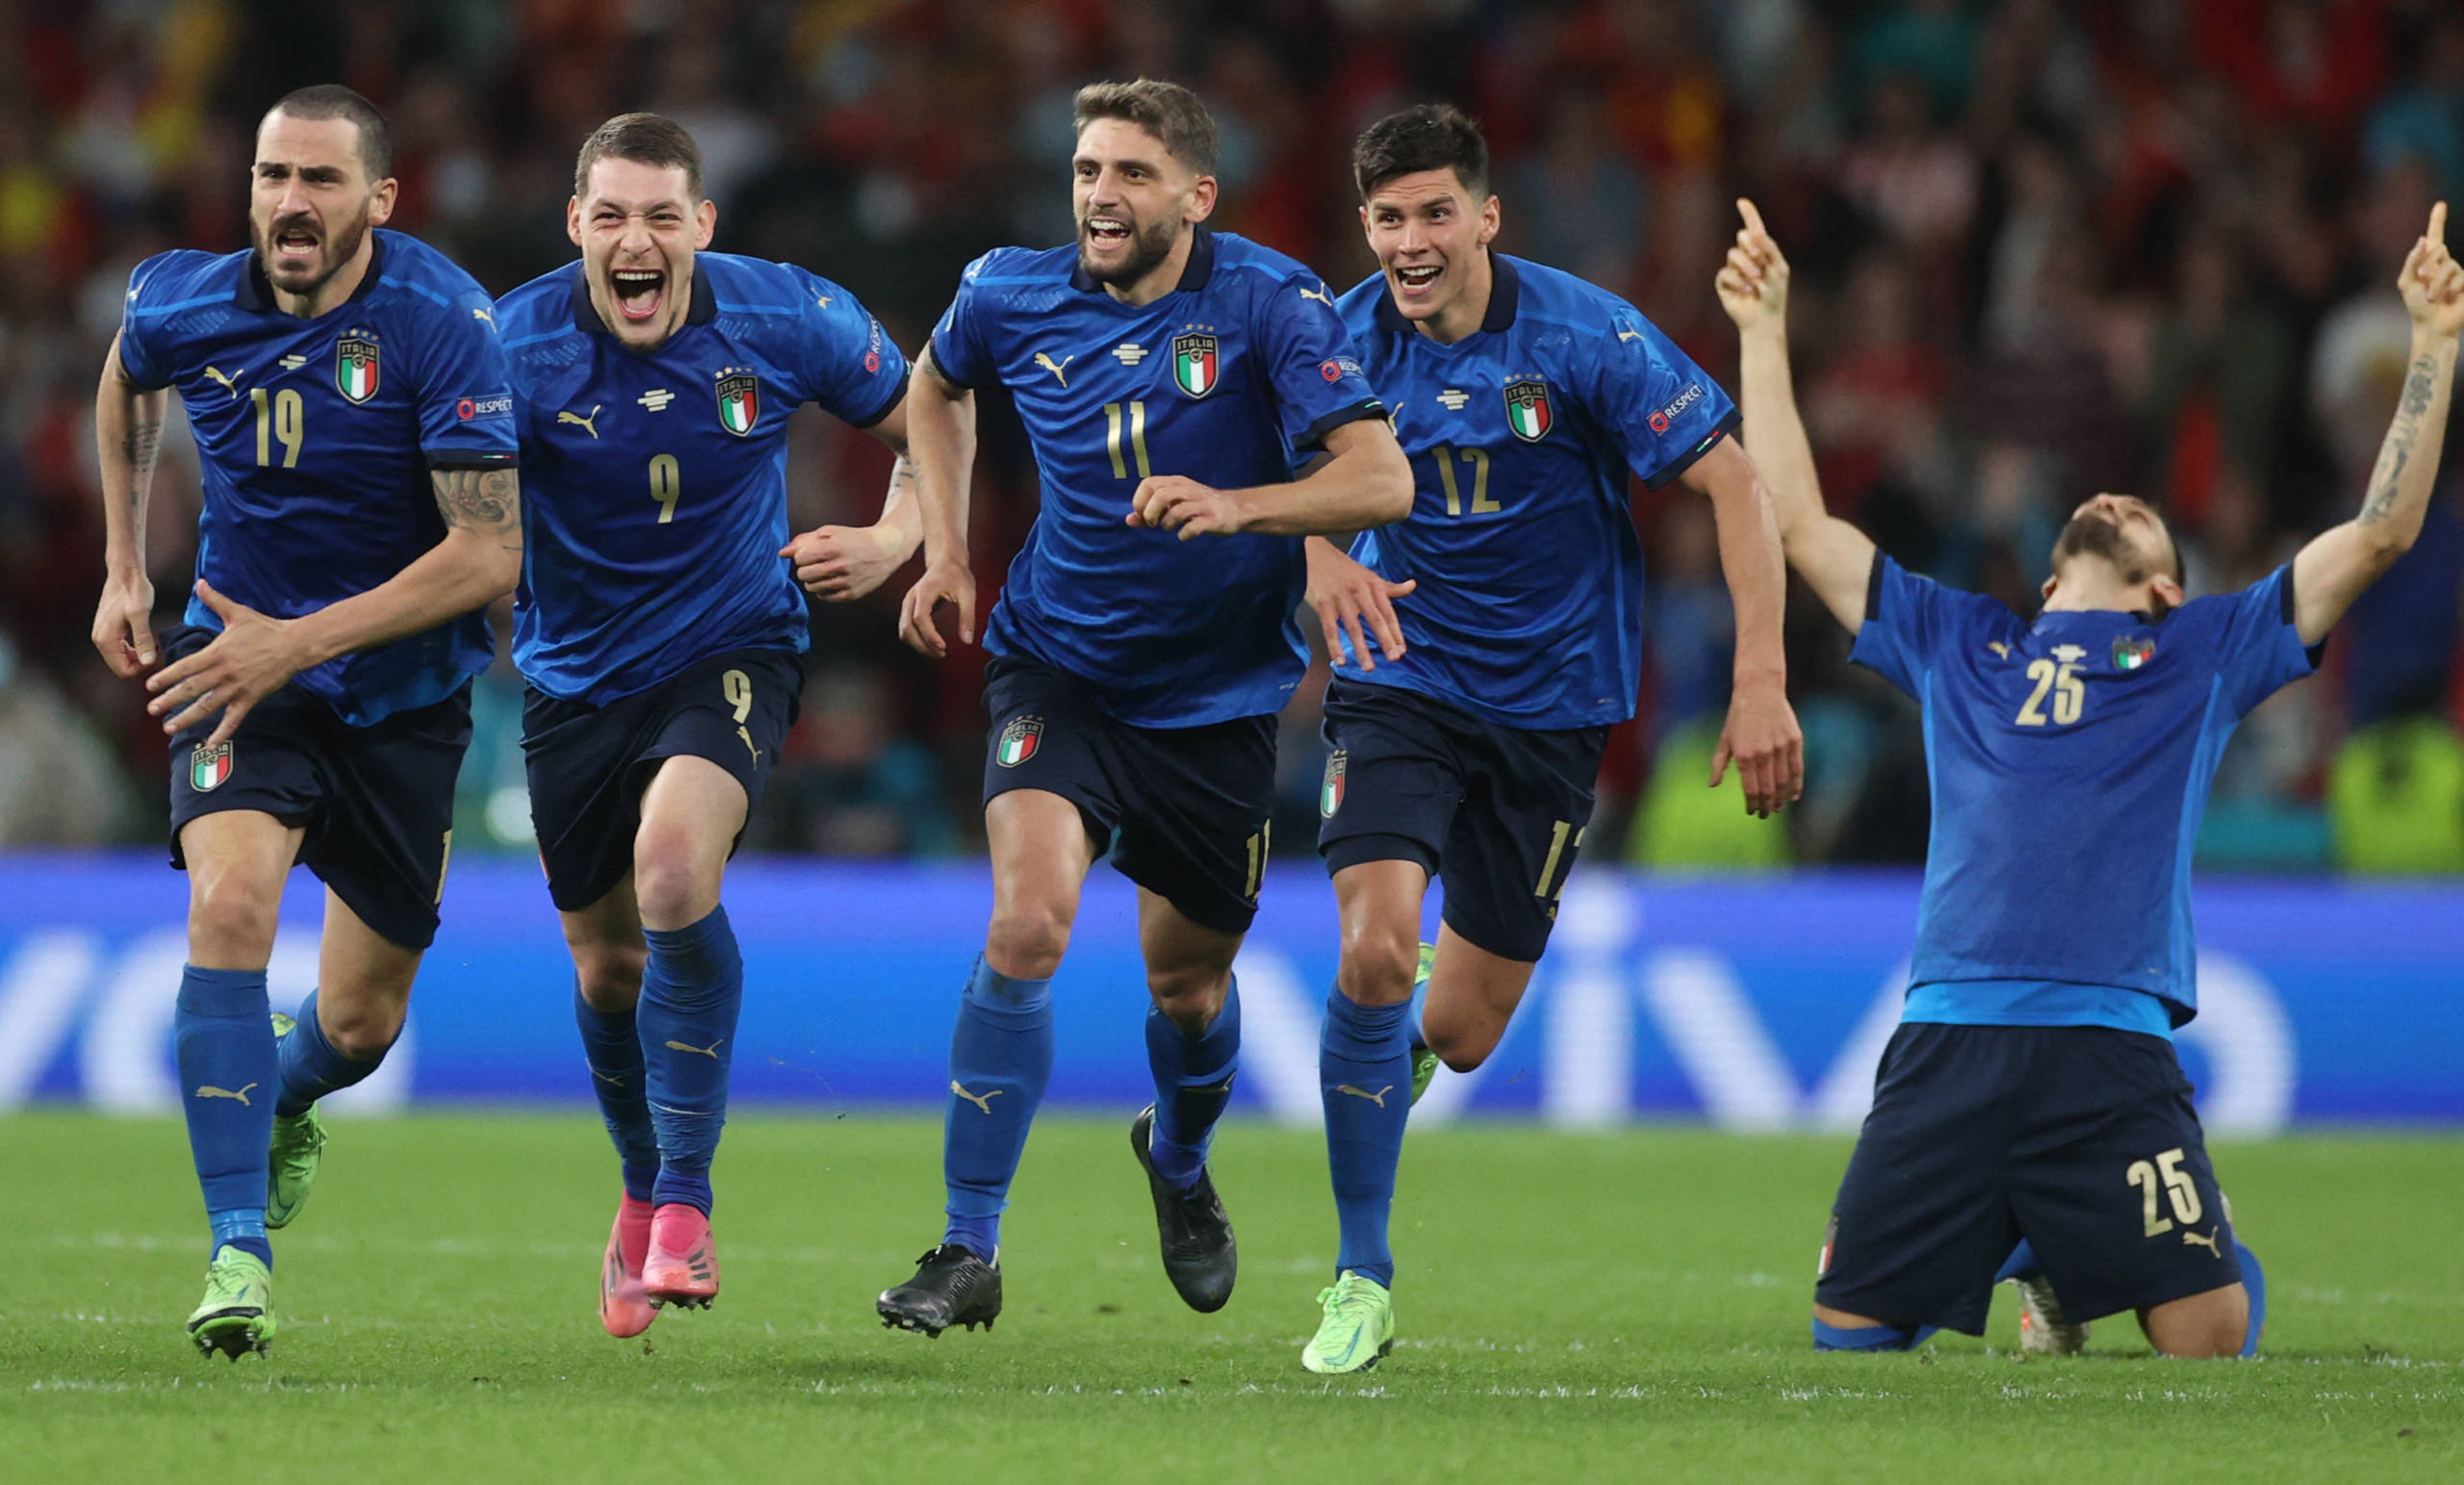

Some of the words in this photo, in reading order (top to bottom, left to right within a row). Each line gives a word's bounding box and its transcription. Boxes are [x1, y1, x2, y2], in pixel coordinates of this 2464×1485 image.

[341, 344, 376, 356] ITALIA
[1176, 338, 1214, 349] ITALIA
[475, 398, 513, 414] RESPECT
[719, 378, 754, 395] ITALIA
[1507, 386, 1545, 398] ITALIA
[1664, 384, 1703, 419] RESPECT
[250, 388, 303, 469] 19
[1104, 401, 1151, 479] 11
[648, 453, 680, 524] 9
[1431, 448, 1502, 516] 12
[722, 669, 752, 724] 9
[2015, 658, 2087, 727] 25
[2125, 1147, 2203, 1238] 25
